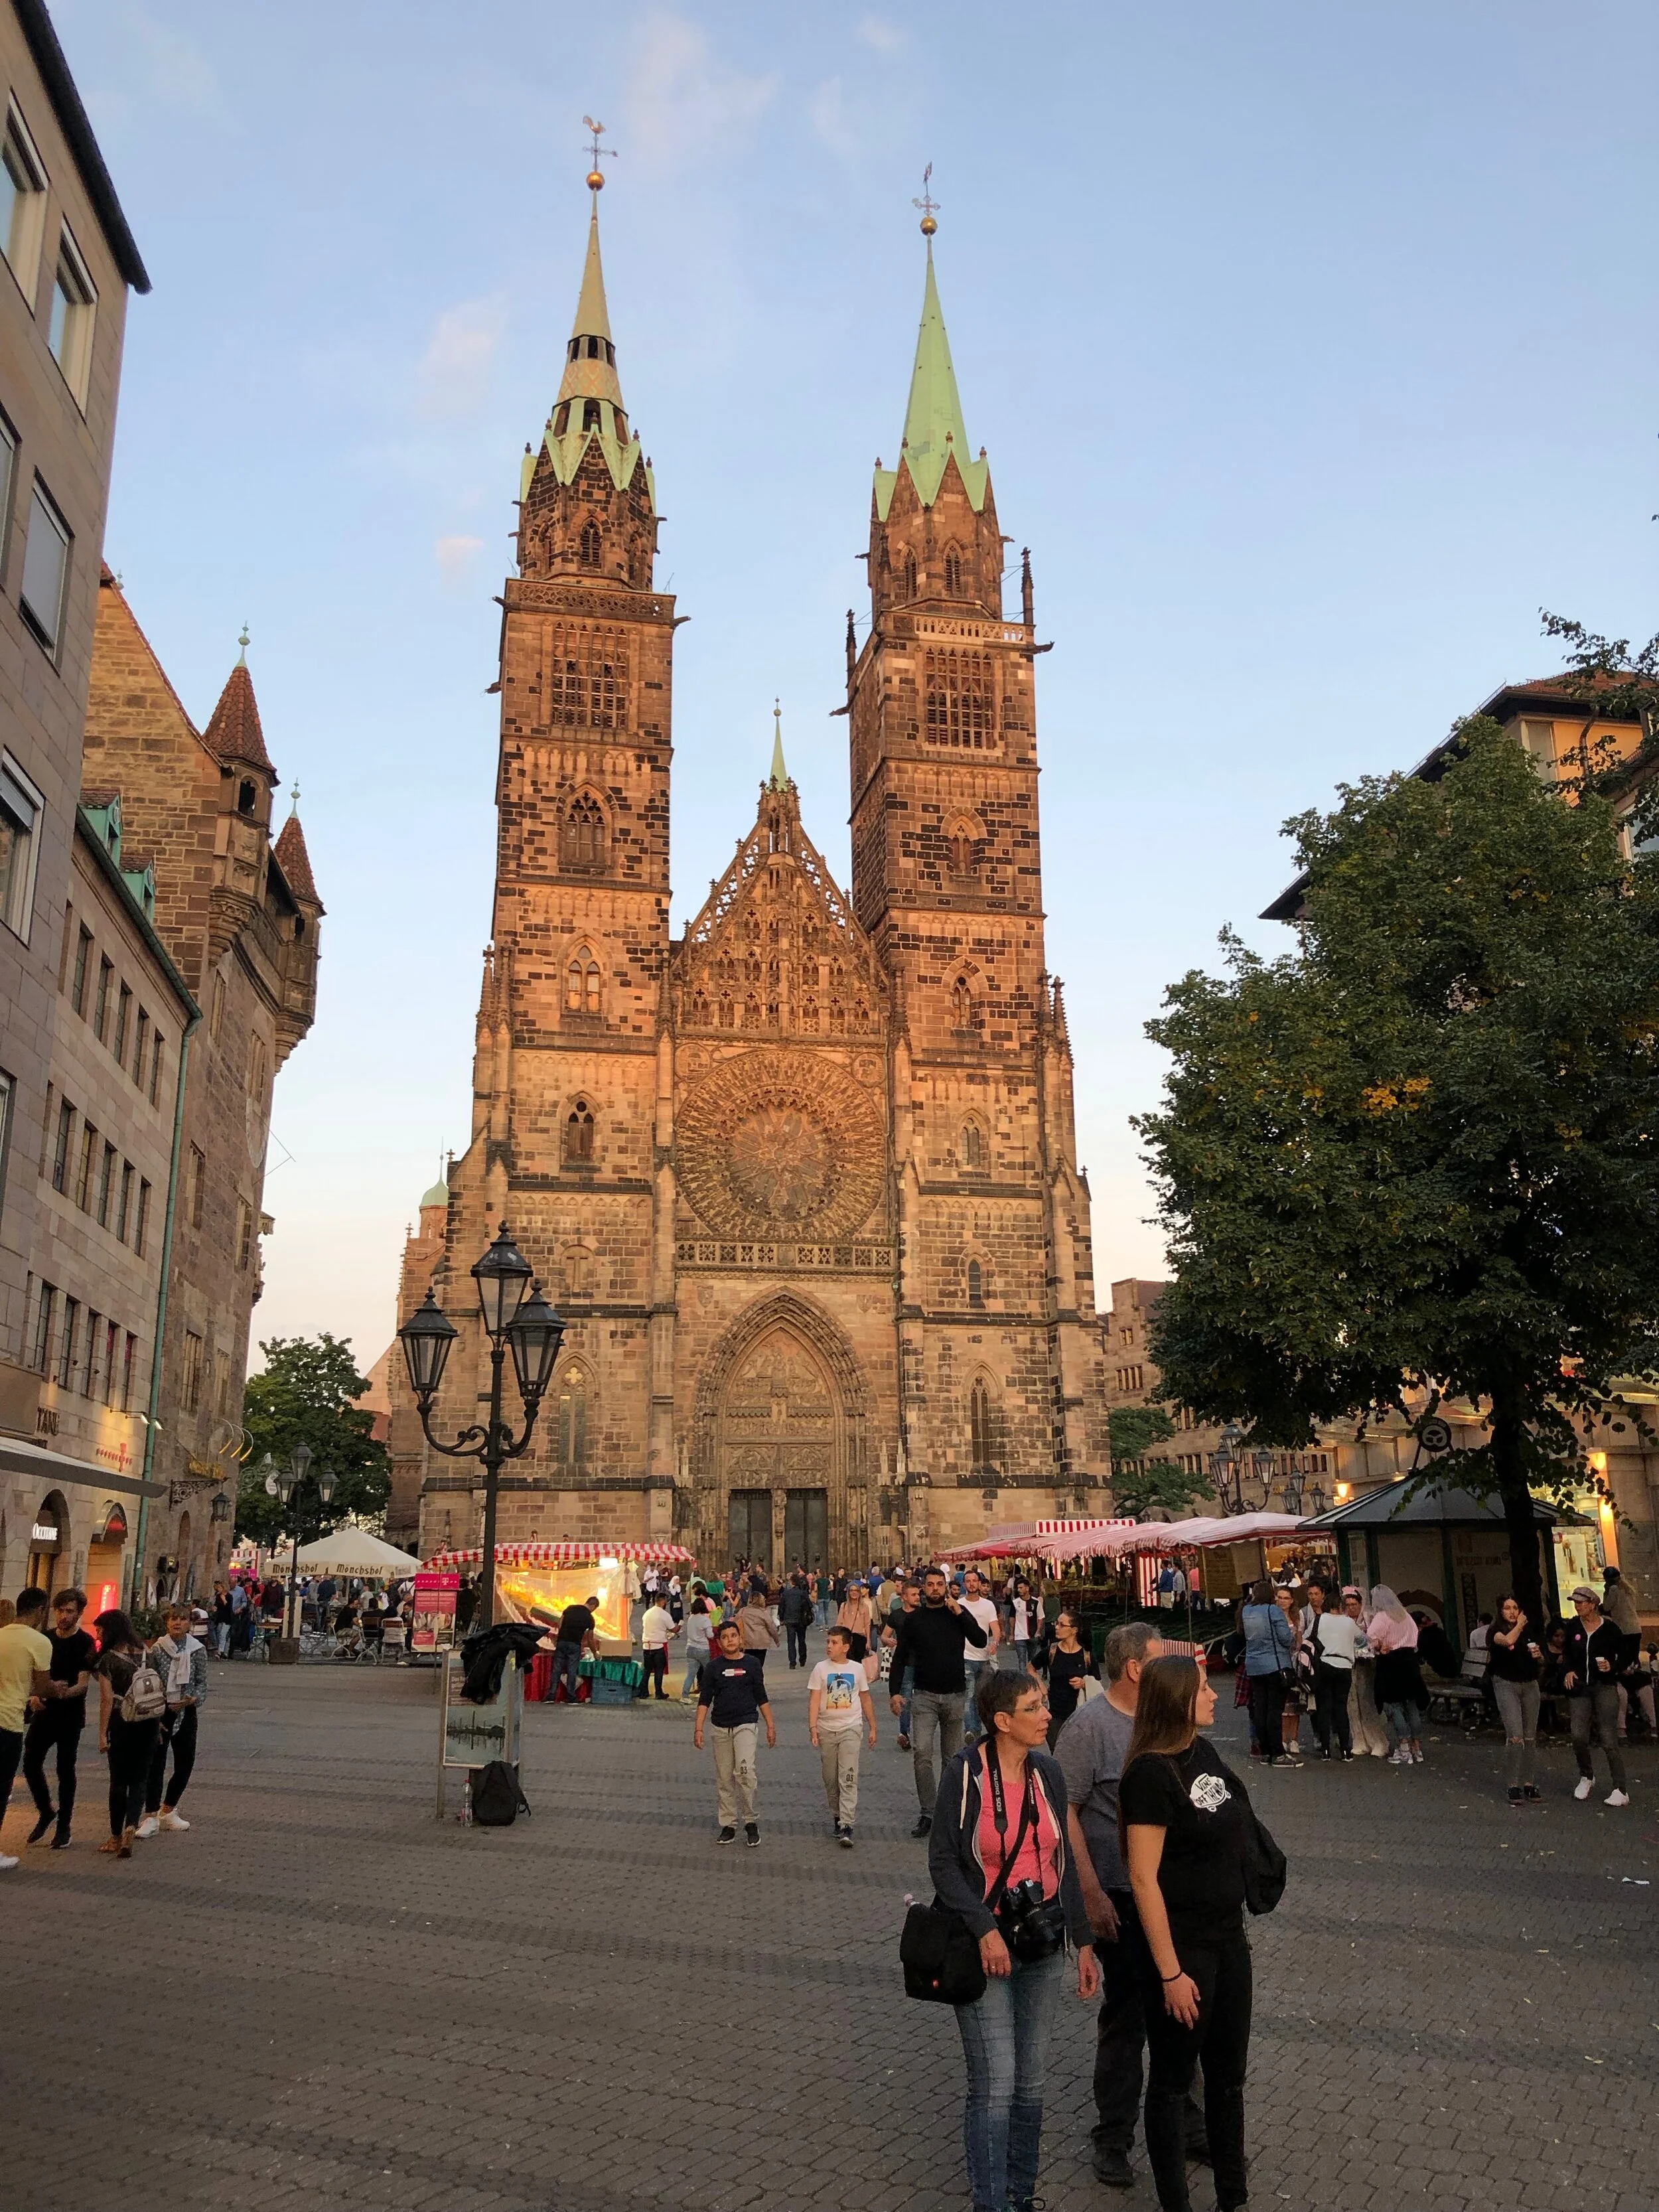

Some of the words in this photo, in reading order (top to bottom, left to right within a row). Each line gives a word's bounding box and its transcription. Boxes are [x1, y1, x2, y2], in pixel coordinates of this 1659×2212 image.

[273, 1564, 319, 1574] Mönhshof
[740, 1766, 747, 1775] 03
[1194, 1775, 1212, 1791] VANS
